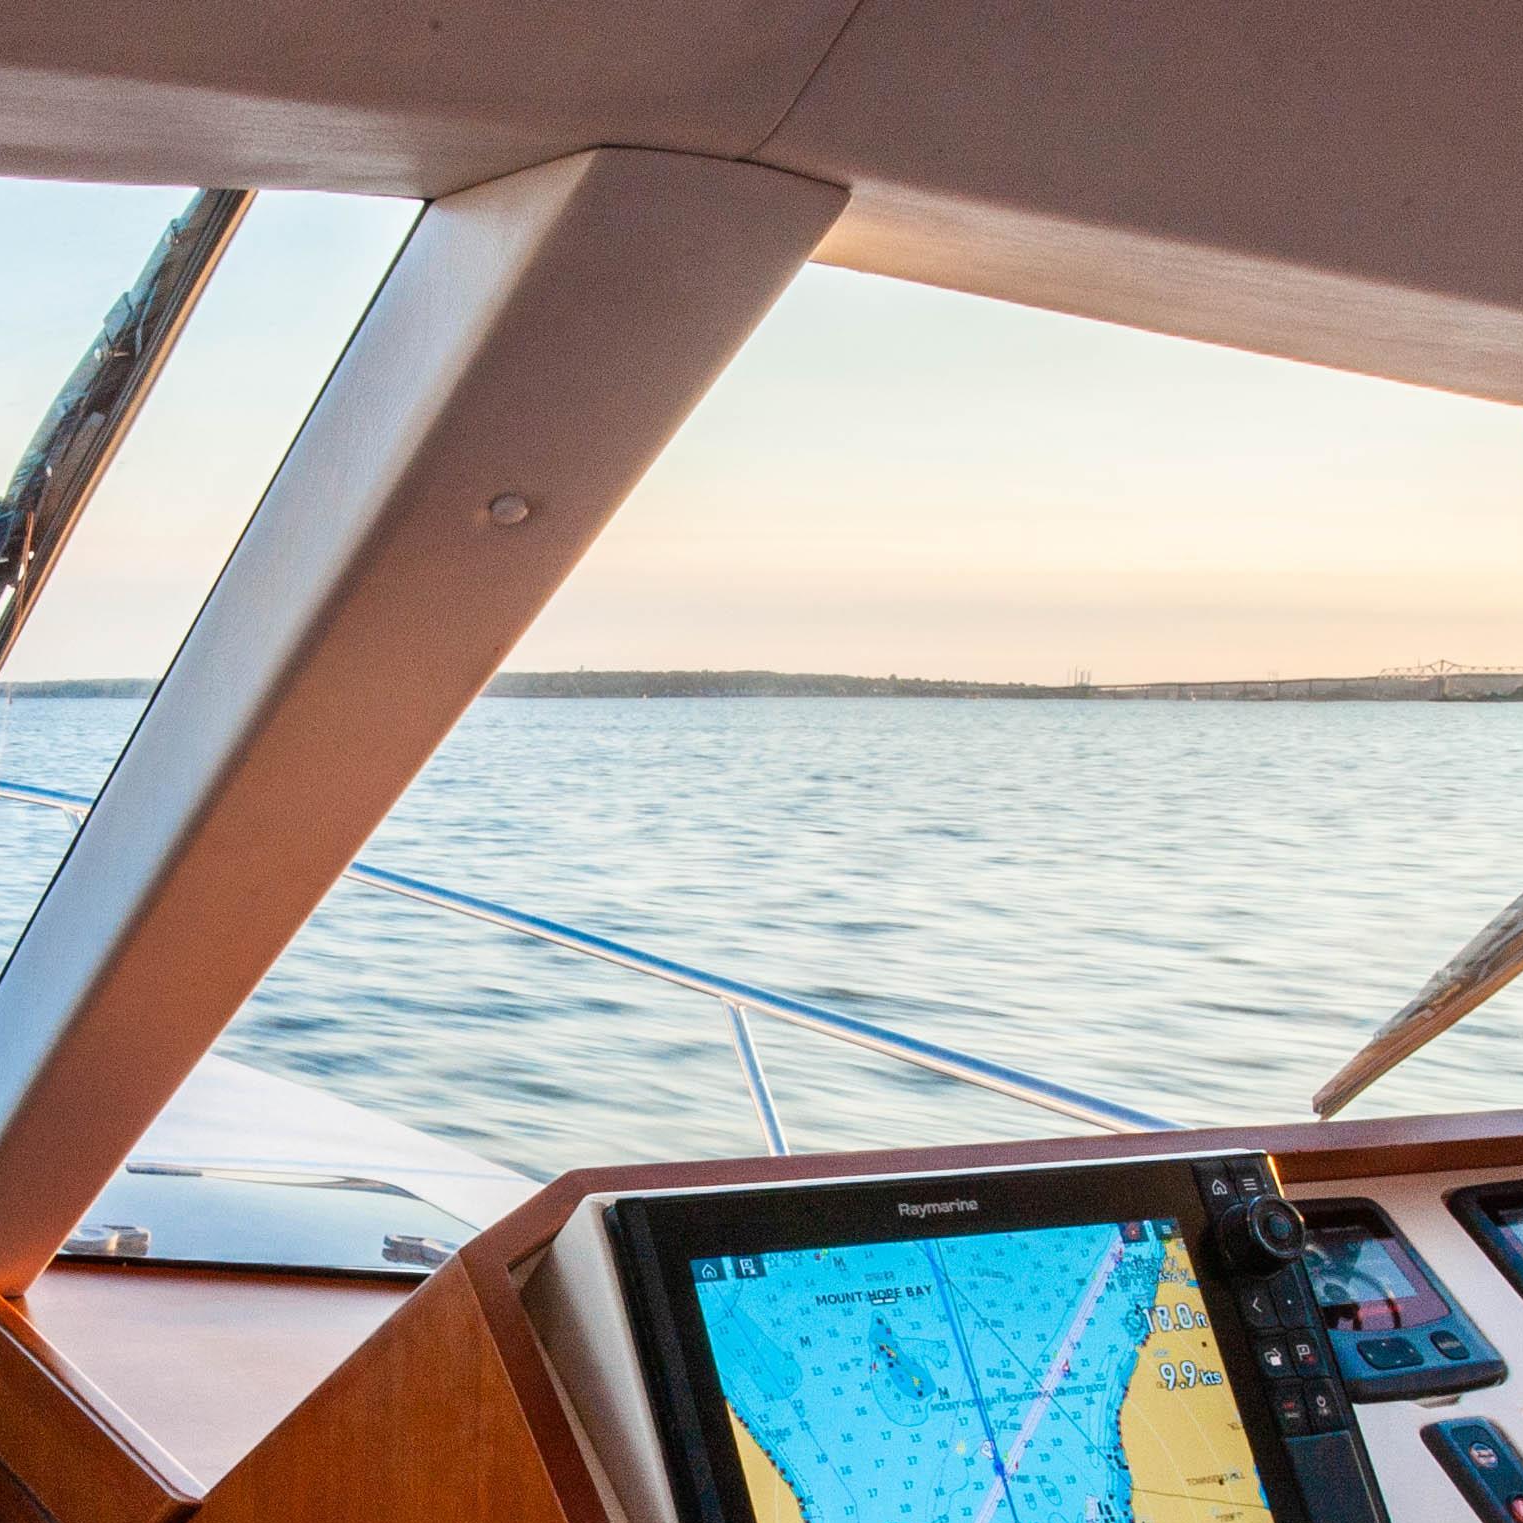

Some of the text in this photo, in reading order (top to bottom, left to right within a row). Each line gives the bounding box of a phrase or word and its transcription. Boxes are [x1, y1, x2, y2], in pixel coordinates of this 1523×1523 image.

[898, 1198, 979, 1219] Raymarine
[815, 1285, 933, 1306] MOUNT HOPE BAY
[1194, 1312, 1209, 1328] ft
[801, 1336, 812, 1348] M
[851, 1337, 862, 1346] 17
[838, 1363, 850, 1371] 16
[1159, 1360, 1223, 1391] 9.9 kts
[831, 1387, 843, 1396] 15
[856, 1406, 867, 1416] 16
[841, 1433, 854, 1442] 16
[881, 1431, 892, 1440] 17
[910, 1434, 922, 1443] 15
[816, 1454, 828, 1464] 16
[875, 1459, 885, 1468] 17
[907, 1456, 918, 1465] 17
[840, 1466, 852, 1475] 16
[903, 1480, 914, 1489] 17
[868, 1488, 878, 1498] 17
[844, 1506, 855, 1515] 17
